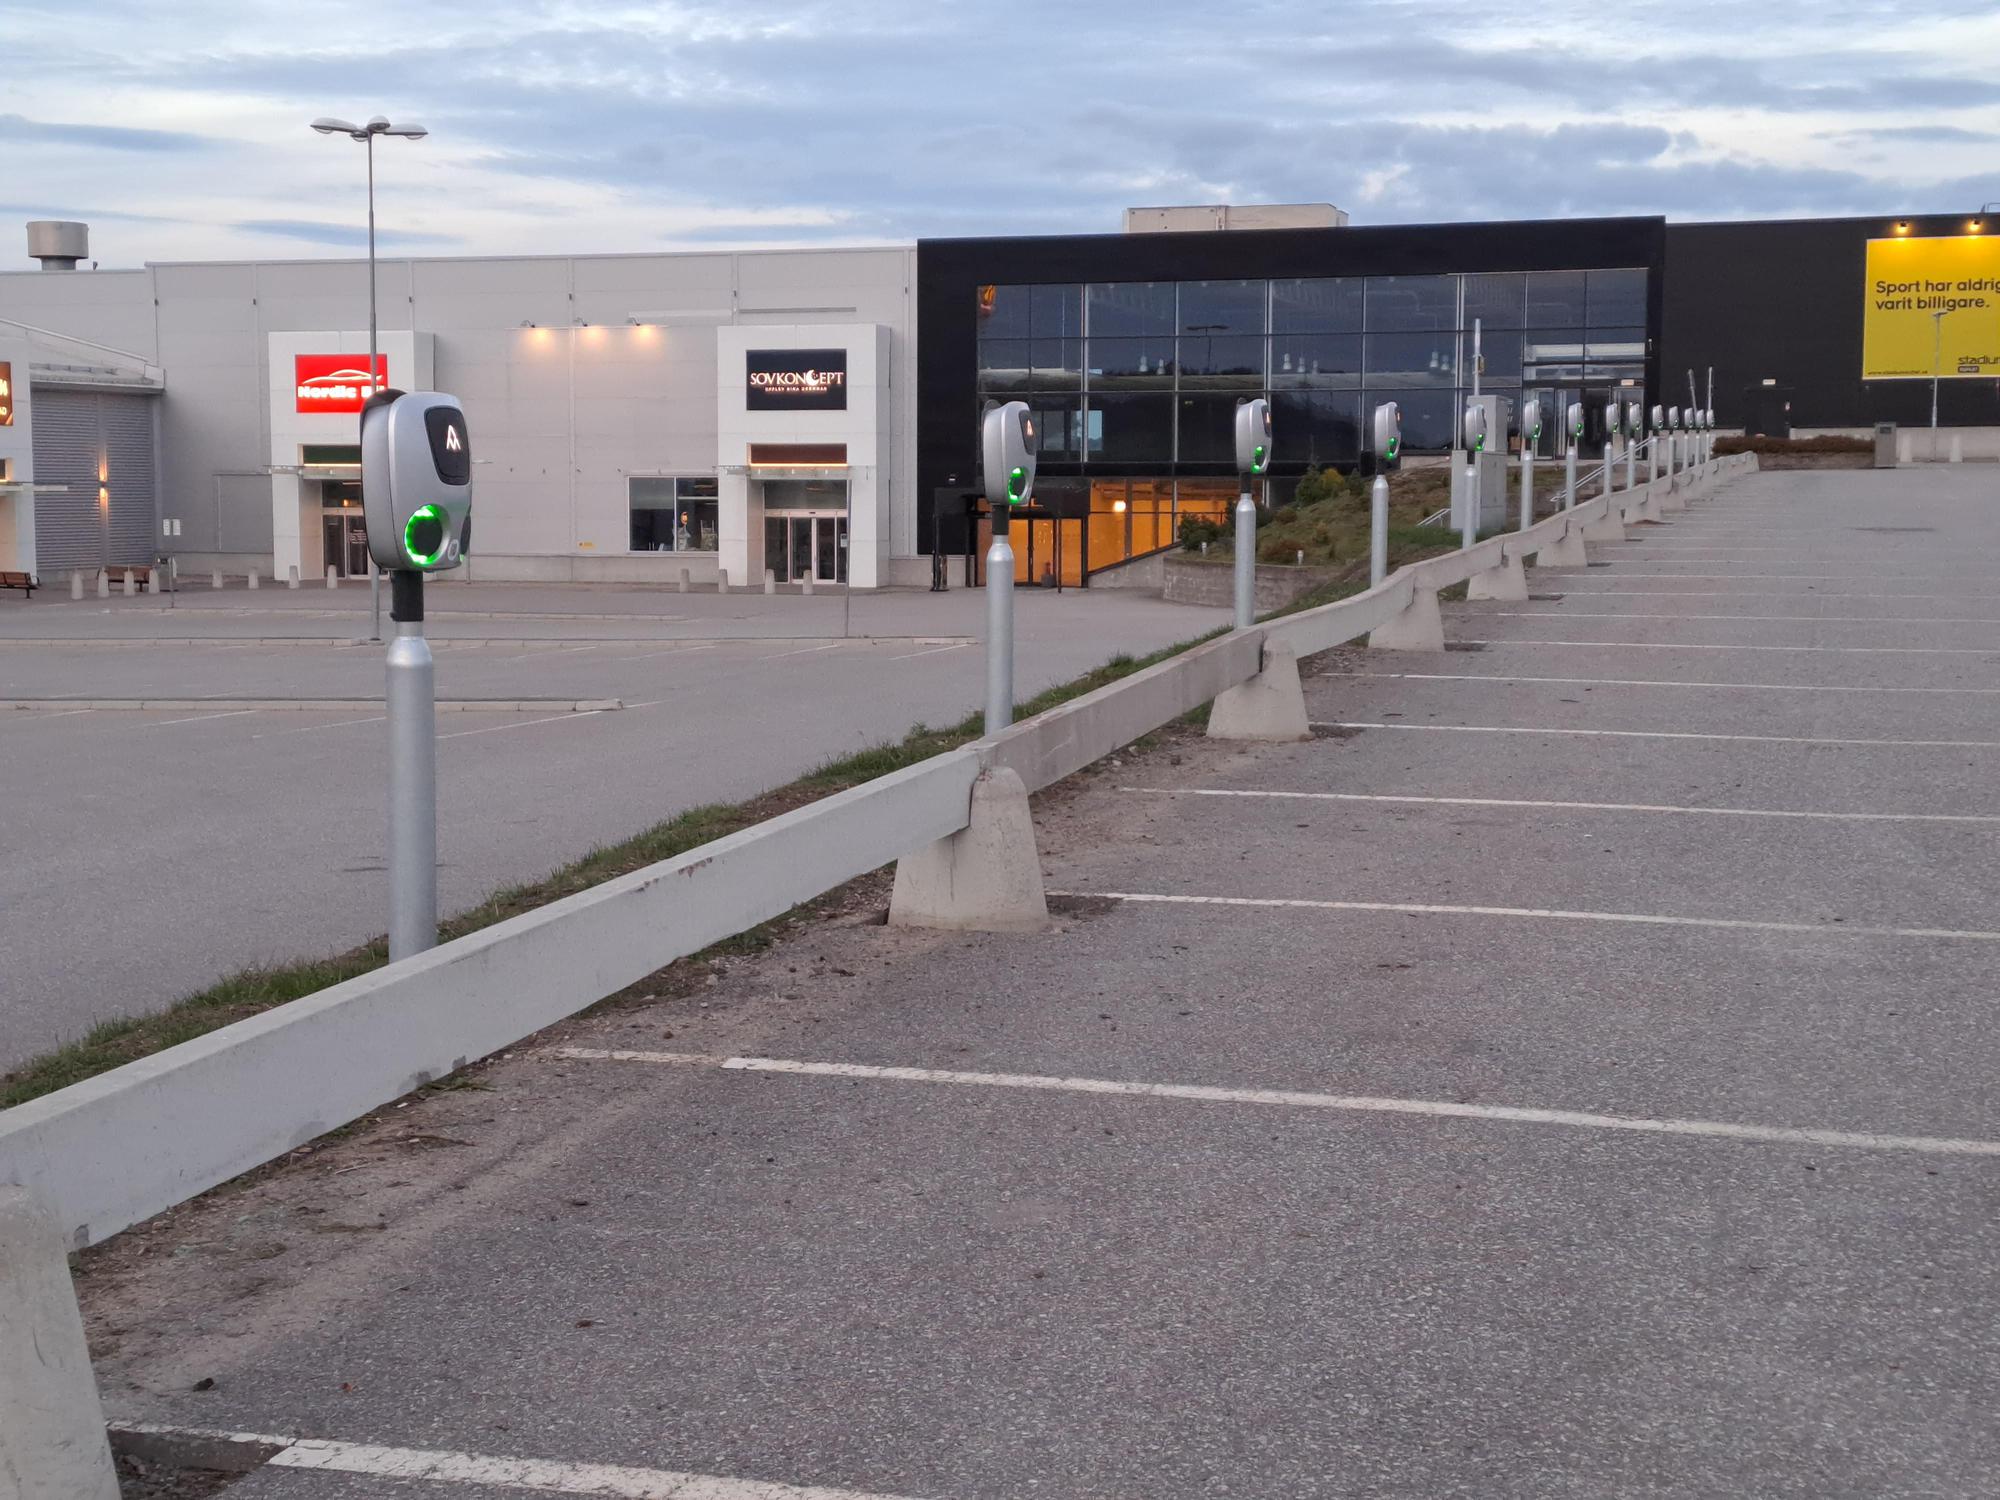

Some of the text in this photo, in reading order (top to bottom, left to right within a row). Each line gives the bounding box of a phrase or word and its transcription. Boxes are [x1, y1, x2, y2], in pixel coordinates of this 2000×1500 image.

[1876, 278, 2000, 296] Sport har aldrig
[1876, 296, 1990, 311] varit billigare.
[1958, 355, 2000, 364] stadiu
[750, 370, 844, 386] SOVKONCEPT
